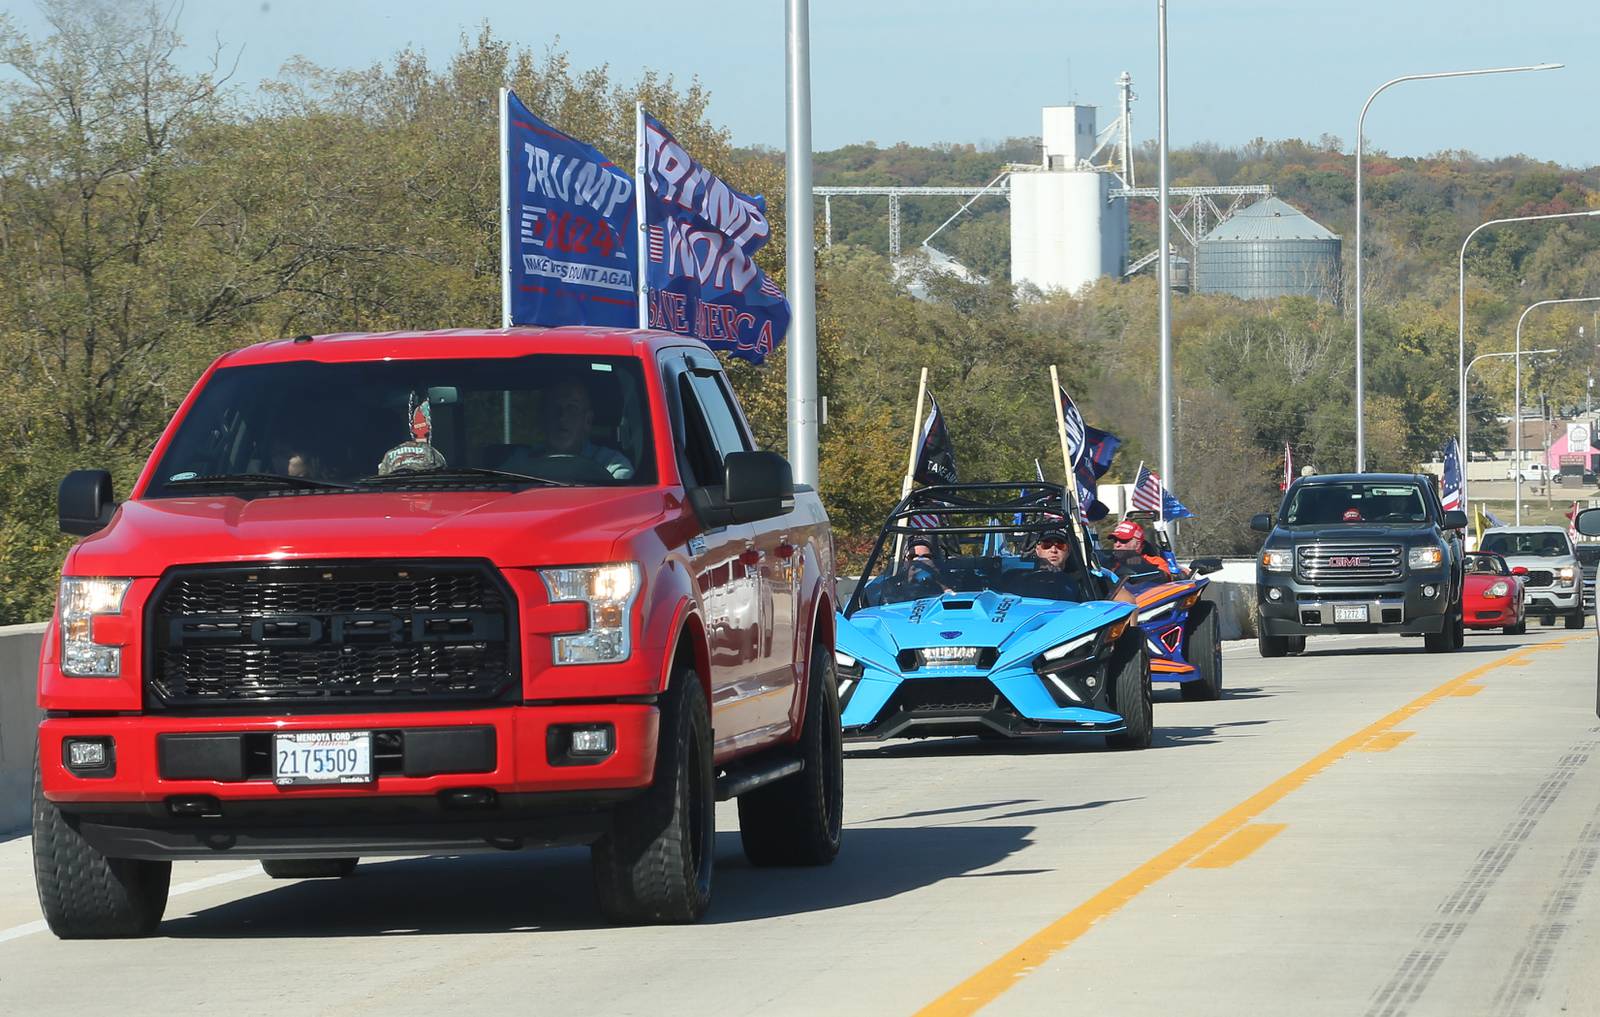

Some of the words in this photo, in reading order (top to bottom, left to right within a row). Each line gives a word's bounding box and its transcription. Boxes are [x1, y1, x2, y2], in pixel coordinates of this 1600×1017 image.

[525, 142, 632, 217] TRUMP
[667, 215, 758, 293] WON
[1328, 556, 1370, 567] GMC
[170, 612, 505, 646] FORD
[296, 733, 330, 742] MENDOTA
[331, 731, 350, 742] FORD
[279, 748, 357, 774] 2175509
